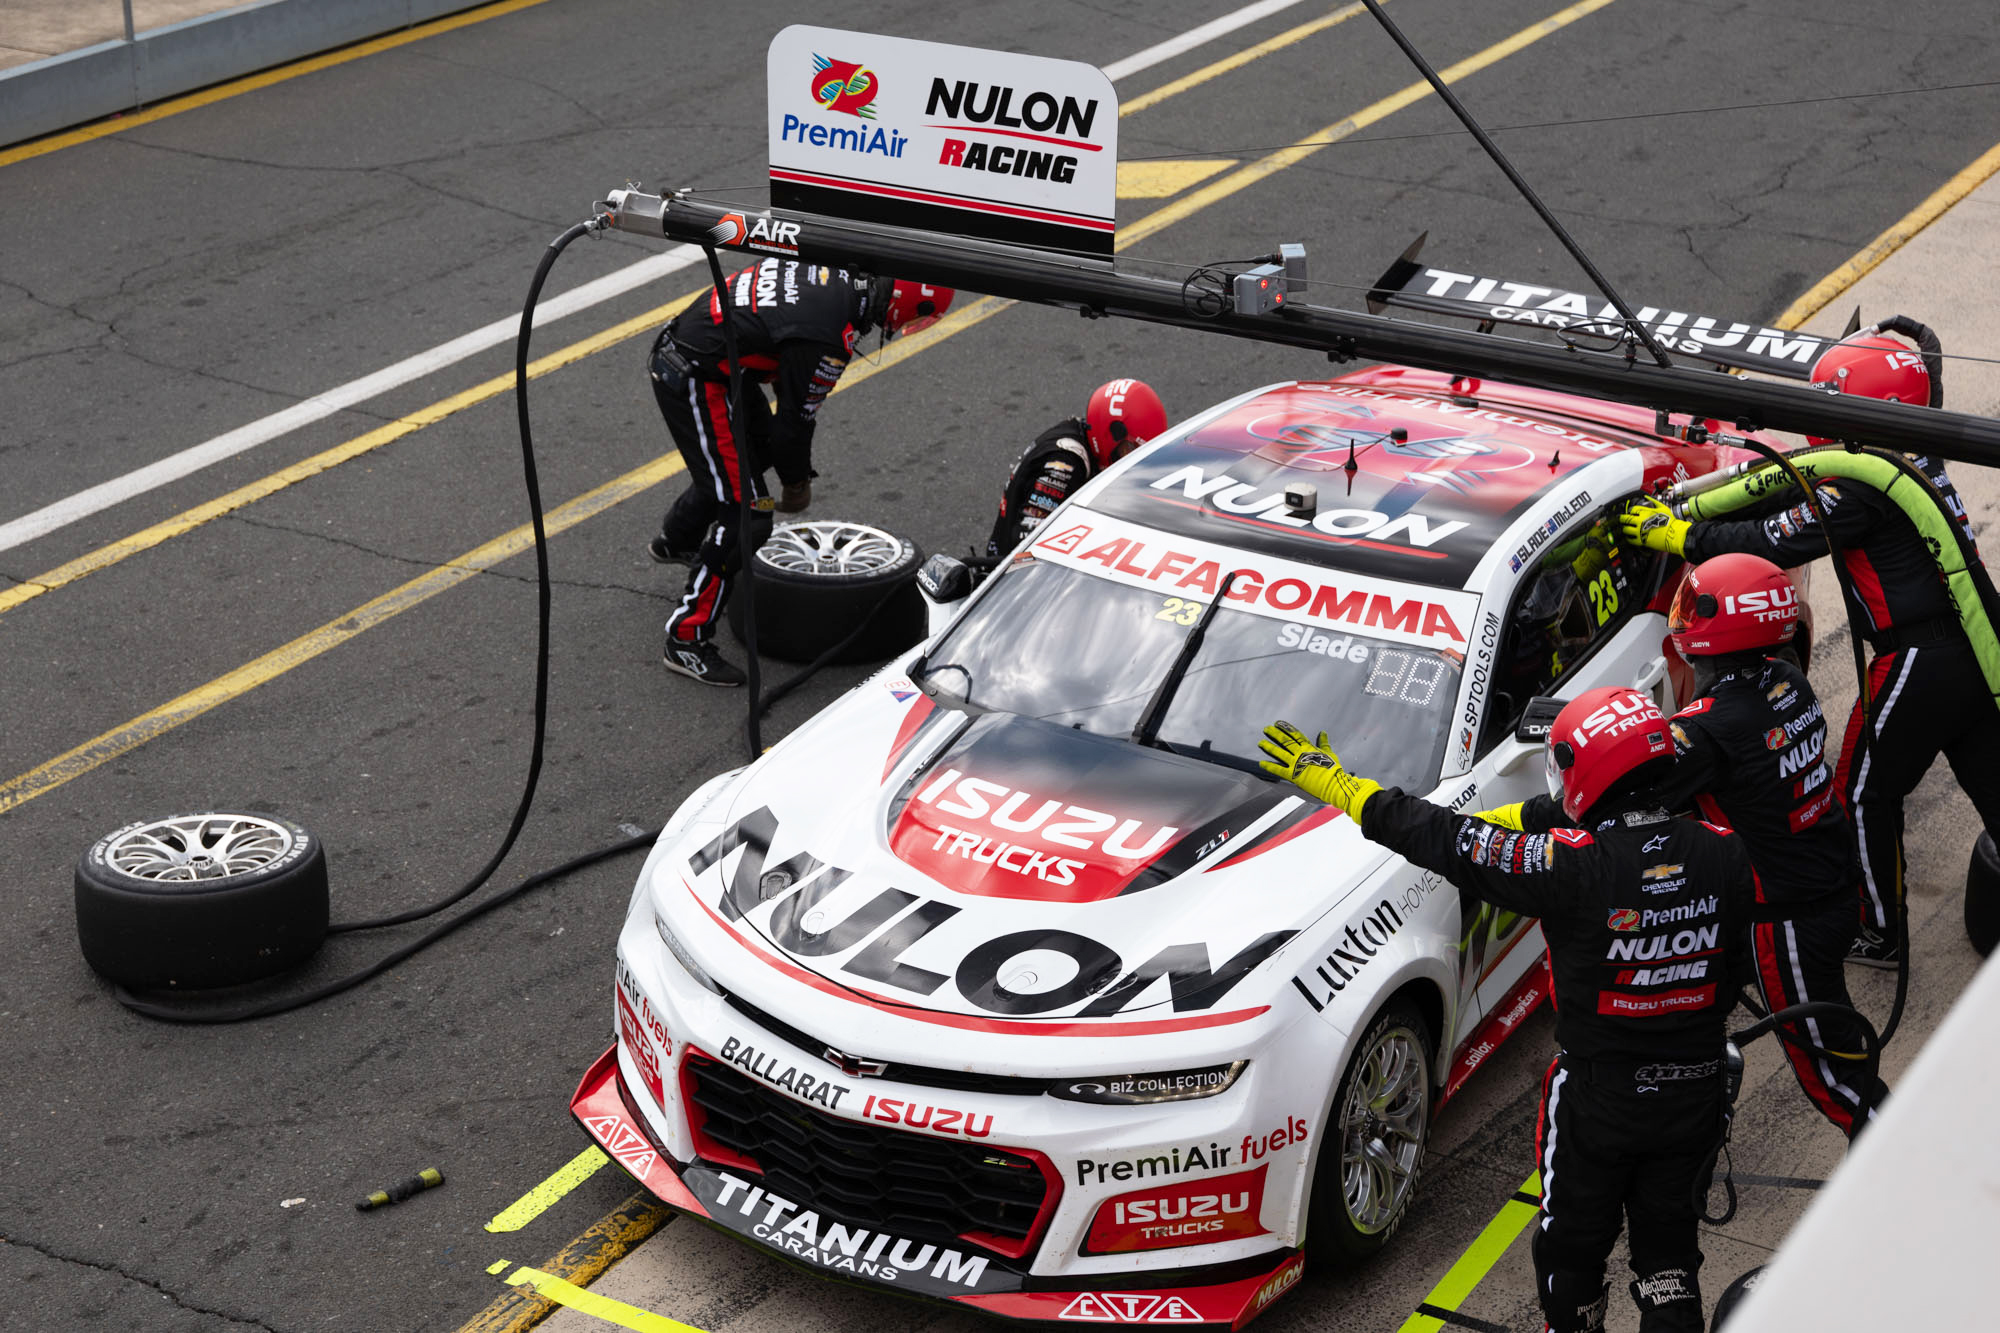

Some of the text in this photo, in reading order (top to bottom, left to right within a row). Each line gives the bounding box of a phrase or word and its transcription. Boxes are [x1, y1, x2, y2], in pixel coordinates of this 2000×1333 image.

[925, 78, 1098, 138] NULON
[782, 114, 909, 158] PremiAir
[939, 138, 1078, 184] RACING
[749, 218, 801, 245] AIR
[775, 261, 799, 304] PremiAir
[1402, 397, 1615, 452] PremiAir
[1765, 464, 1817, 488] PIREK
[1149, 465, 1471, 547] NULON
[1553, 490, 1592, 528] McLEOD
[1517, 526, 1551, 563] SLADE
[1077, 536, 1467, 643] ALFAGOMMA
[1589, 570, 1619, 628] 23
[1154, 597, 1204, 627] 23
[1276, 622, 1370, 664] Slade
[1465, 612, 1500, 727] SPTOOLS.COM
[1650, 744, 1666, 753] ANDY
[916, 769, 1179, 860] ISUZU
[932, 826, 1087, 886] TRUCKS
[1642, 878, 1687, 892] CHEVROLET
[1652, 886, 1679, 895] RACING
[688, 805, 1302, 1018] NULON
[1642, 895, 1719, 928] PremiAir
[1291, 900, 1404, 1013] Luxton
[1606, 923, 1720, 961] NULON
[1614, 960, 1709, 986] RACING
[1613, 994, 1705, 1010] ISUZU TRUCKS
[643, 996, 673, 1056] fuels
[720, 1036, 994, 1138] BALLARAT ISUZU
[1110, 1070, 1229, 1093] BIZ COLLECTION
[1077, 1115, 1308, 1186] PremiAir fuels
[1115, 1191, 1249, 1225] ISUZU
[1141, 1219, 1224, 1239] TRUCKS
[715, 1172, 990, 1288] TITANIUM
[752, 1223, 899, 1281] CARAVANS
[1256, 1260, 1304, 1309] NULON
[1637, 1275, 1681, 1298] Mechanix
